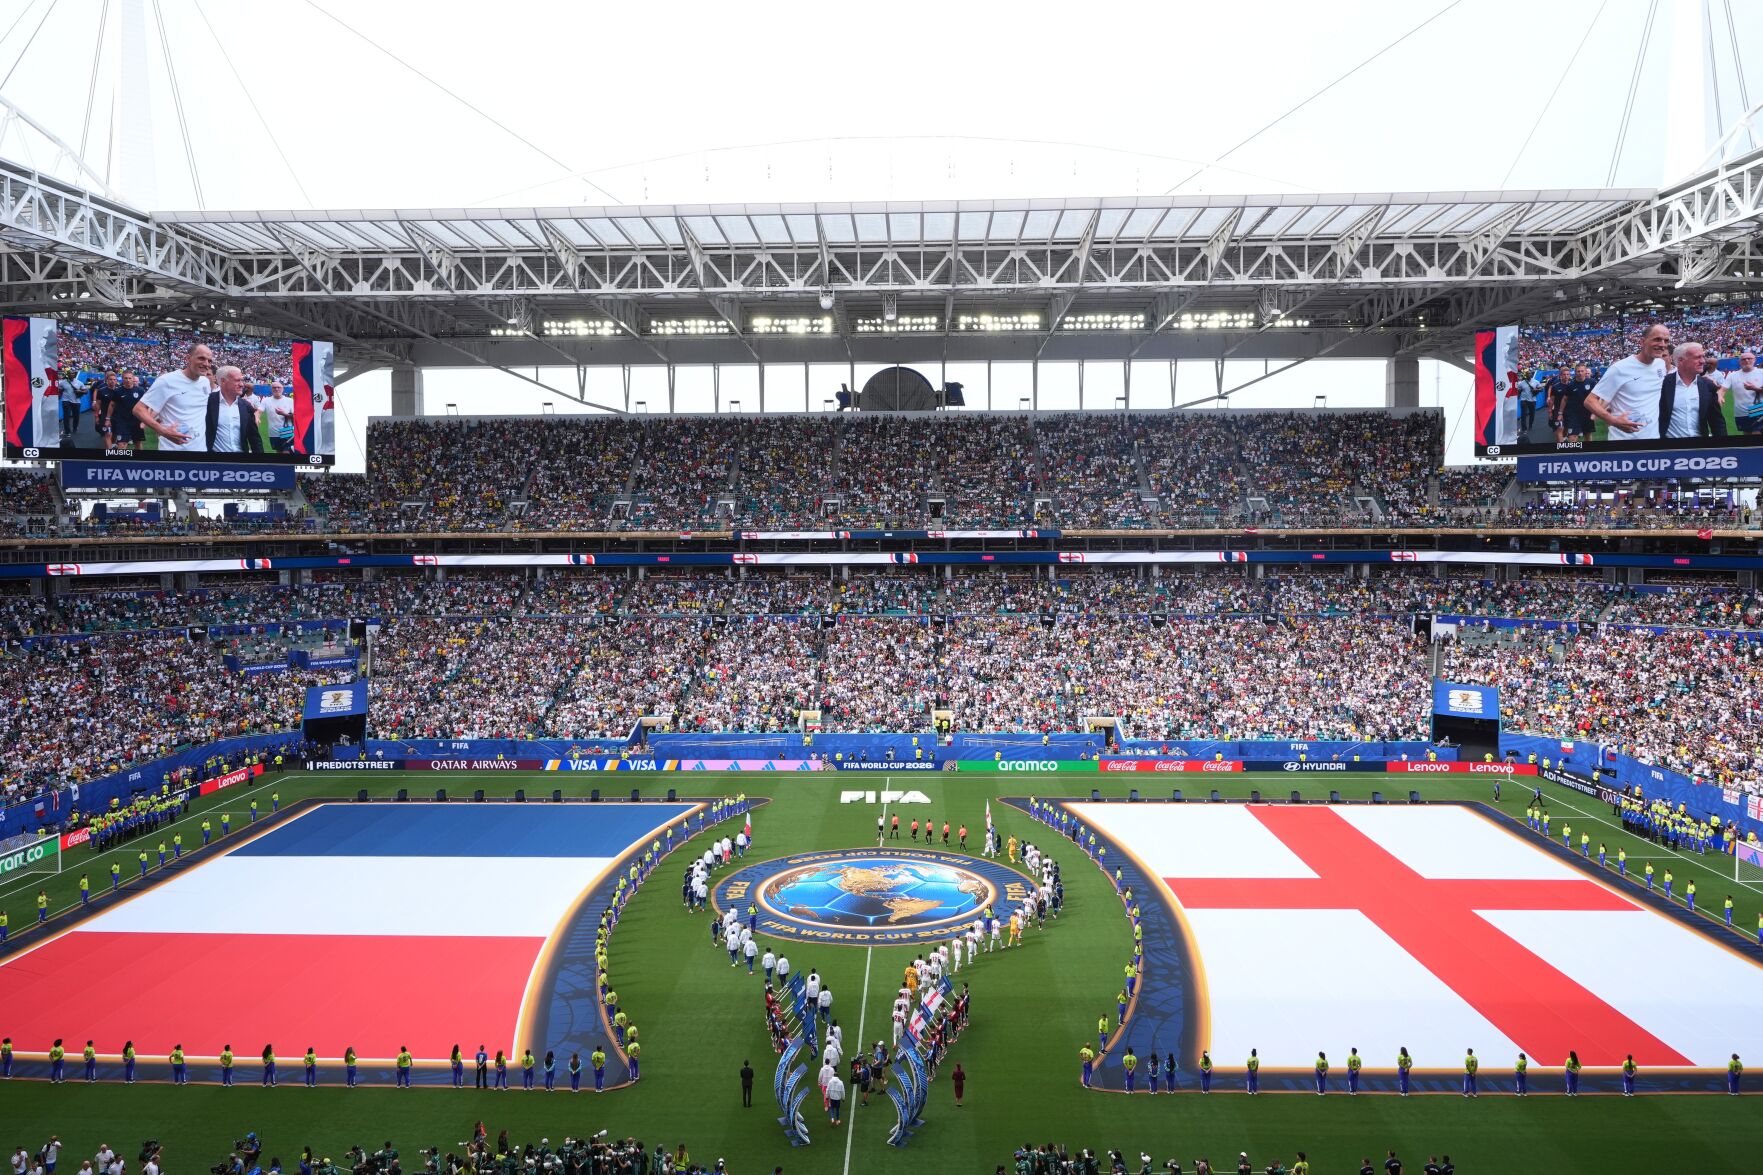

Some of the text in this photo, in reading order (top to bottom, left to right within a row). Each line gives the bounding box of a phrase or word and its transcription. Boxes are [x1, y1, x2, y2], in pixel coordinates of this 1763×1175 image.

[1556, 442, 1583, 451] [MUSIC]
[25, 449, 38, 457] CC
[105, 449, 133, 457] [MUSIC]
[1538, 456, 1738, 475] FIFA WORLD CUP 2026
[87, 468, 276, 483] FIFA WORLD CUP 2026
[452, 742, 469, 750] FIFA
[316, 761, 395, 770] PREDICTSTREET
[431, 760, 518, 770] QATAR AIRWAYS
[567, 760, 598, 771] VISA
[626, 760, 657, 771] VISA
[998, 760, 1058, 771] aramco
[1107, 760, 1138, 771] Coca-Cola
[1155, 760, 1186, 771] Coca-Cola
[1203, 760, 1233, 771] Coca-Cola
[1302, 763, 1346, 771] HYUNDAI
[1407, 762, 1450, 772] Lenovo
[1469, 763, 1514, 773] Lenovo
[128, 771, 142, 782] FIFA
[218, 772, 246, 788] Lenovo
[1651, 769, 1664, 781] FIFA
[1543, 770, 1597, 795] ADI PREDICTSTREET
[840, 790, 932, 804] FIFA
[1601, 791, 1617, 805] QAT
[879, 851, 936, 859] WORLD
[940, 855, 973, 866] FIFA
[726, 881, 751, 900] FIFA
[1004, 882, 1027, 901] FIFA
[761, 919, 798, 934] FIFA
[800, 929, 870, 940] WORLD
[916, 921, 974, 938] 2026
